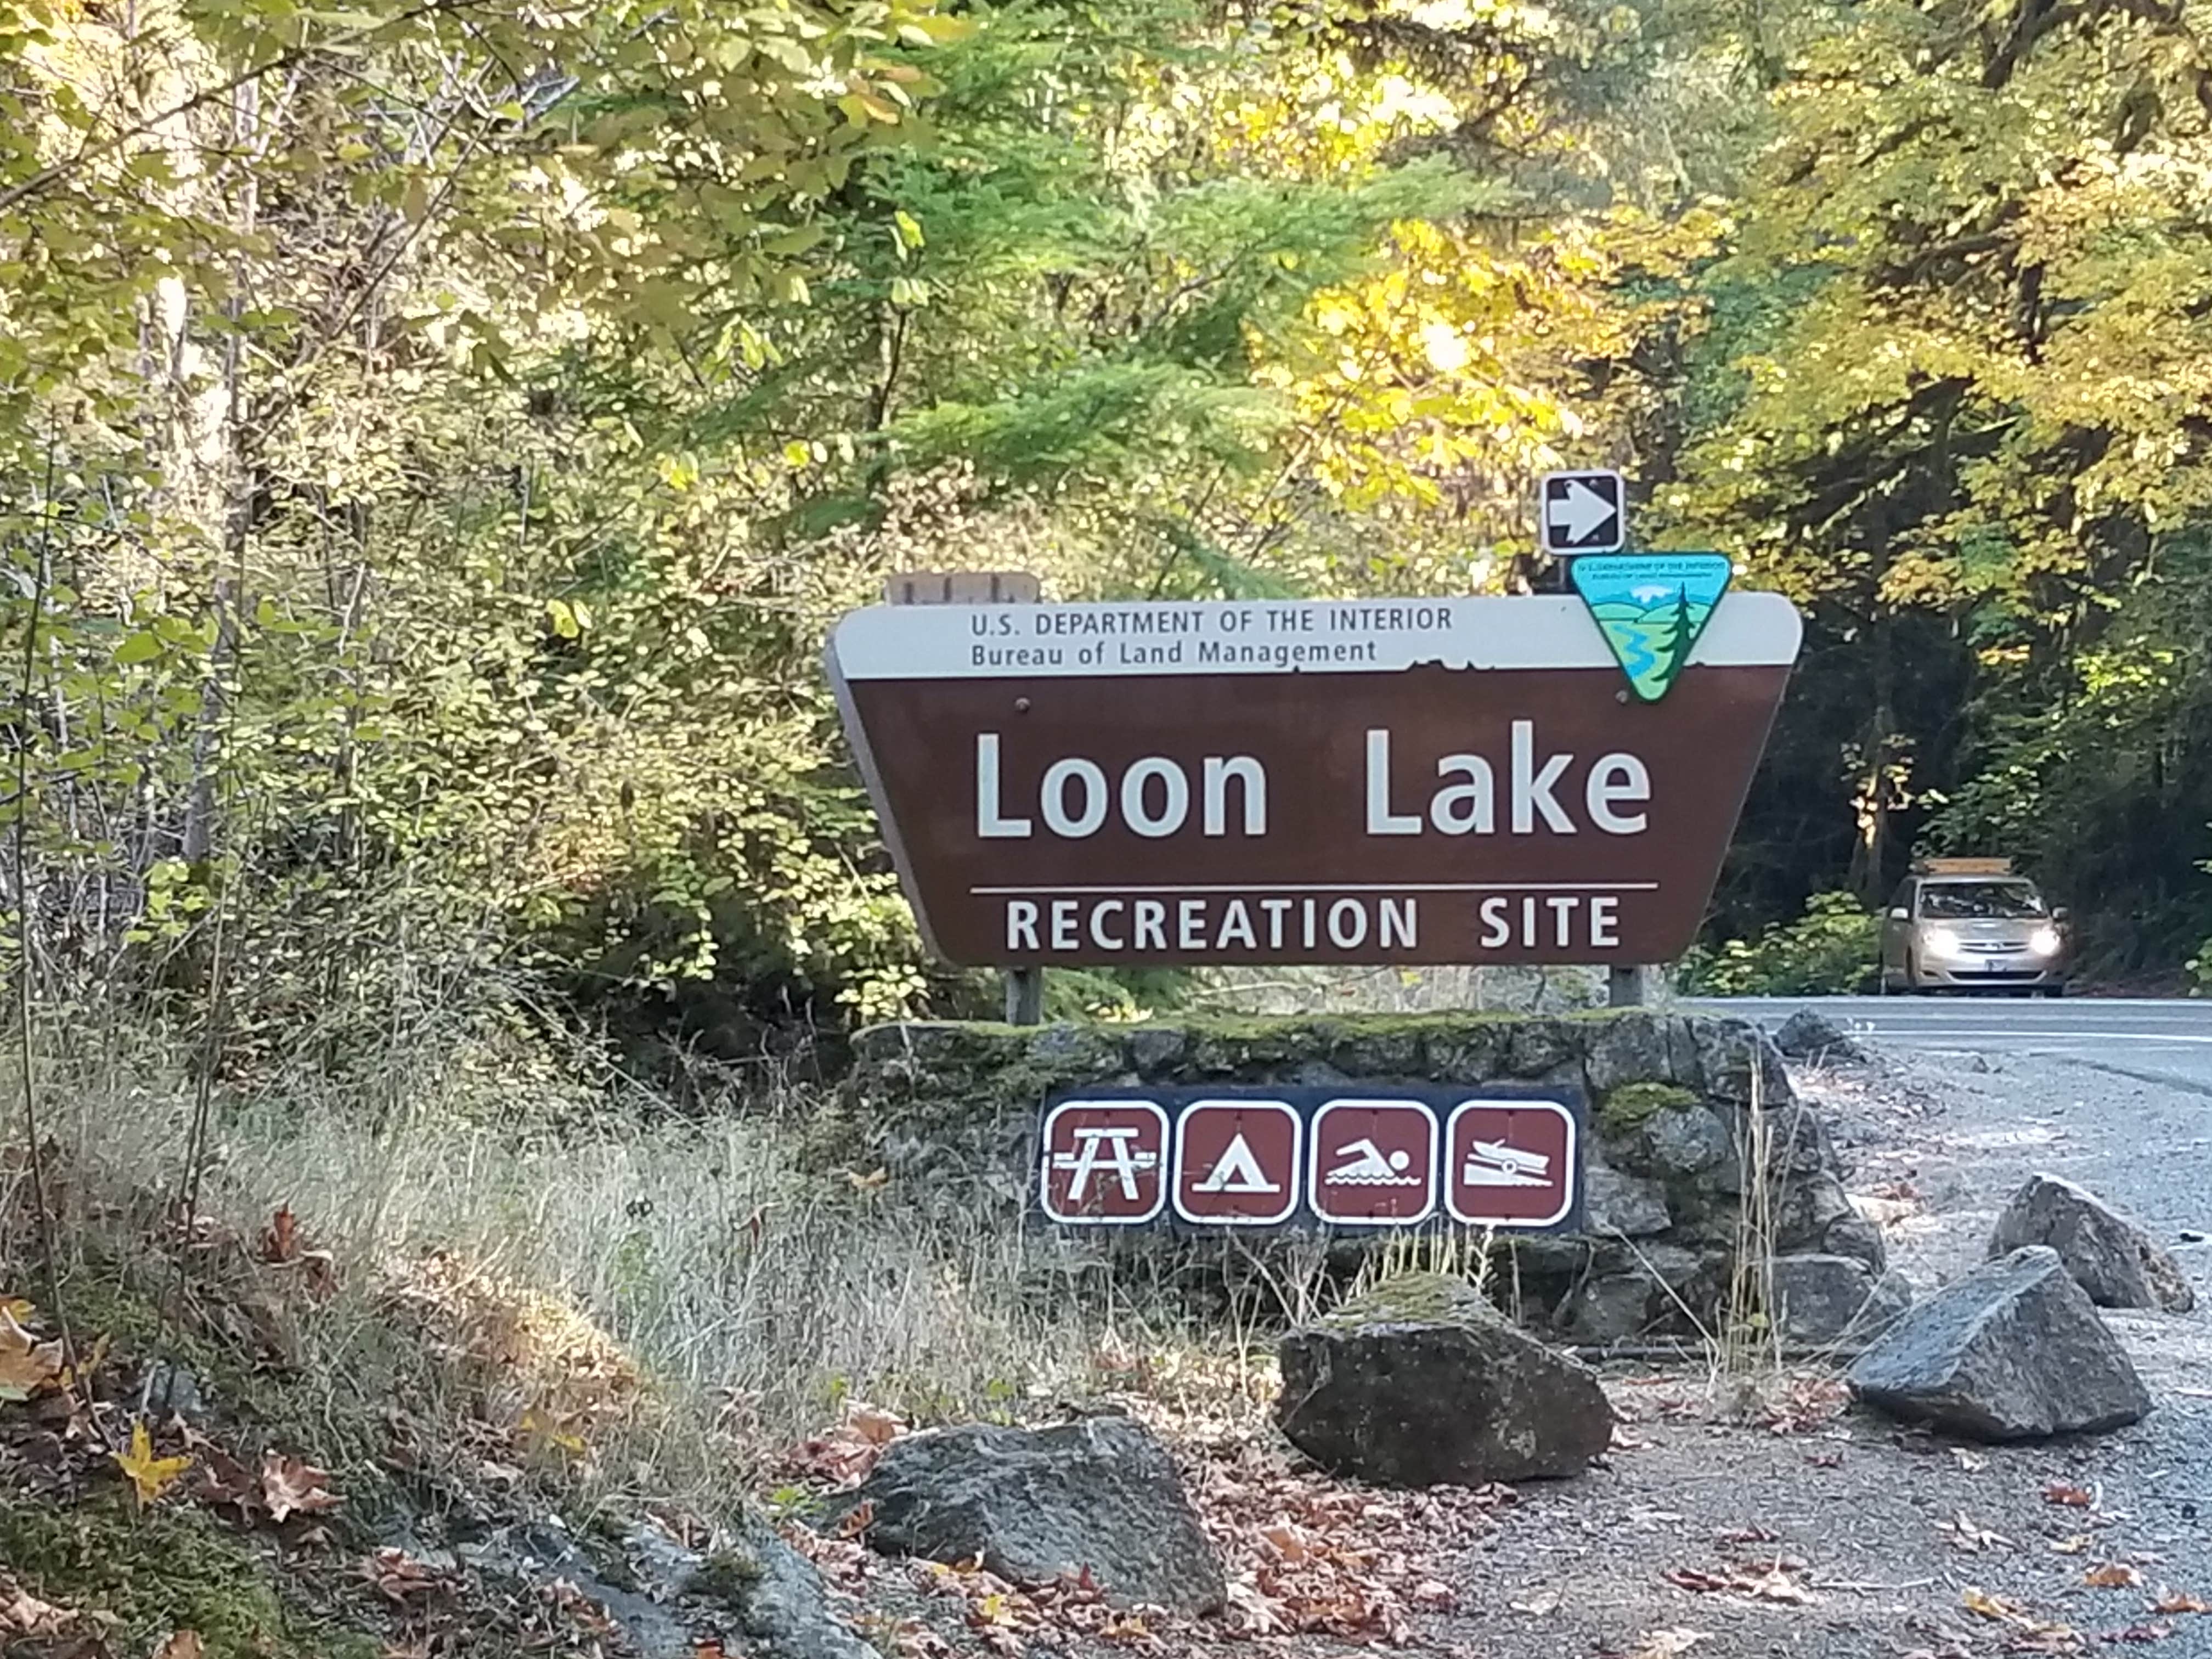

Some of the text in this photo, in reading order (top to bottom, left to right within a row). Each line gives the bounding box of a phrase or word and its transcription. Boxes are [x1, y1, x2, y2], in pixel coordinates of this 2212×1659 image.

[972, 608, 1452, 636] U.S. DEPARTMENT OF THE INTERIOR
[972, 640, 1376, 668] Bureau of Land Management
[978, 720, 1650, 837] Loon Lake
[1008, 896, 1619, 949] RECREATION SITE
